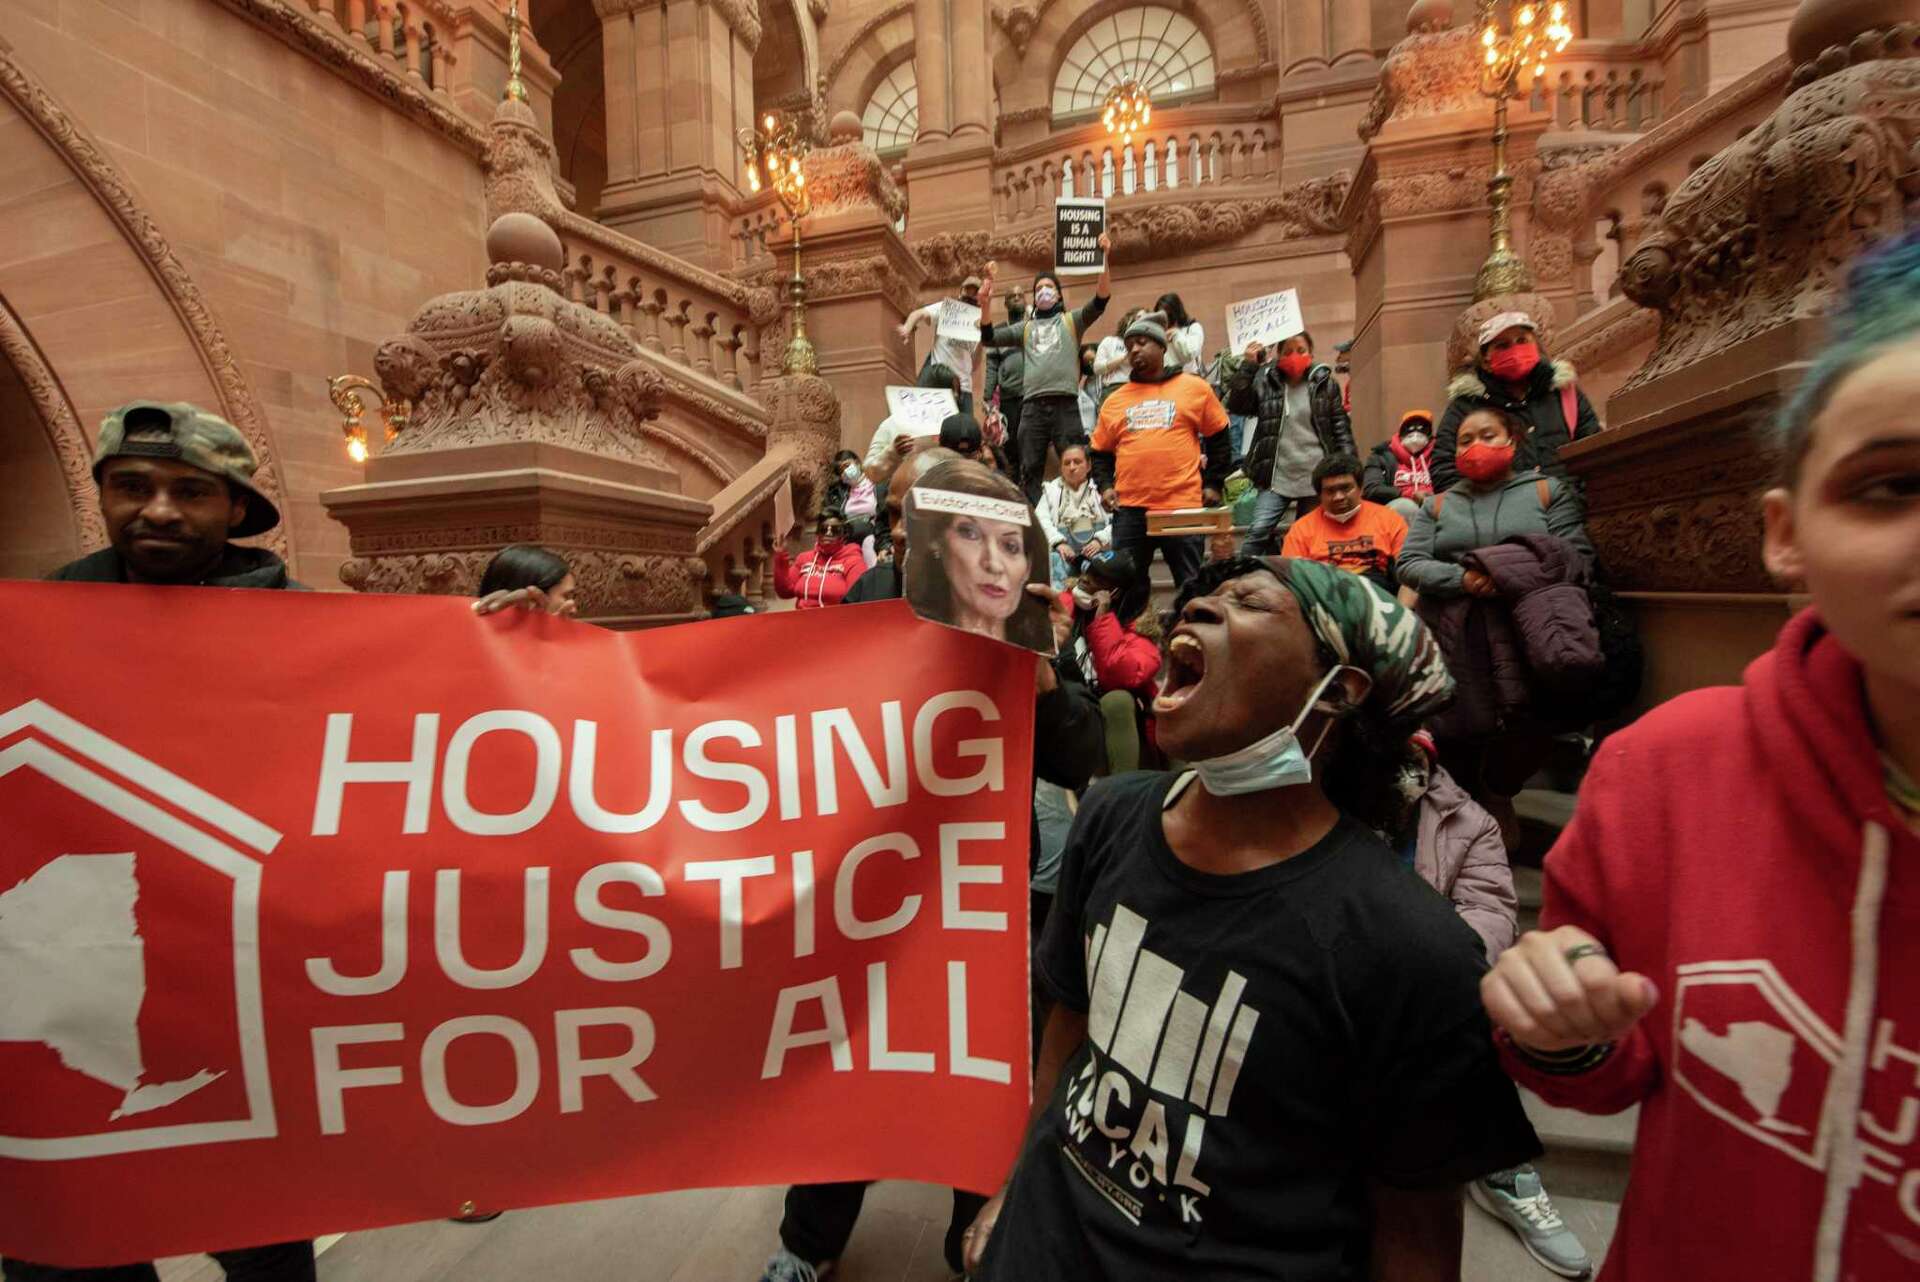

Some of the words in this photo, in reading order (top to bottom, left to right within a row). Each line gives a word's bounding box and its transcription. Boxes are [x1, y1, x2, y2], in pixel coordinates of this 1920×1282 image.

[1060, 208, 1101, 222] HOUSING
[1070, 222, 1080, 235] IS
[1081, 222, 1090, 235] A
[1063, 236, 1097, 249] HUMAN
[1063, 249, 1096, 263] RIGHT!
[1232, 294, 1287, 318] HOUSING
[1236, 304, 1287, 330] JUSTICE
[1264, 315, 1292, 333] ALL
[311, 689, 1006, 837] HOUSING
[304, 821, 1009, 997] JUSTICE
[310, 1006, 659, 1136] FOR
[760, 960, 1012, 1085] ALL
[1107, 1142, 1203, 1223] YOK
